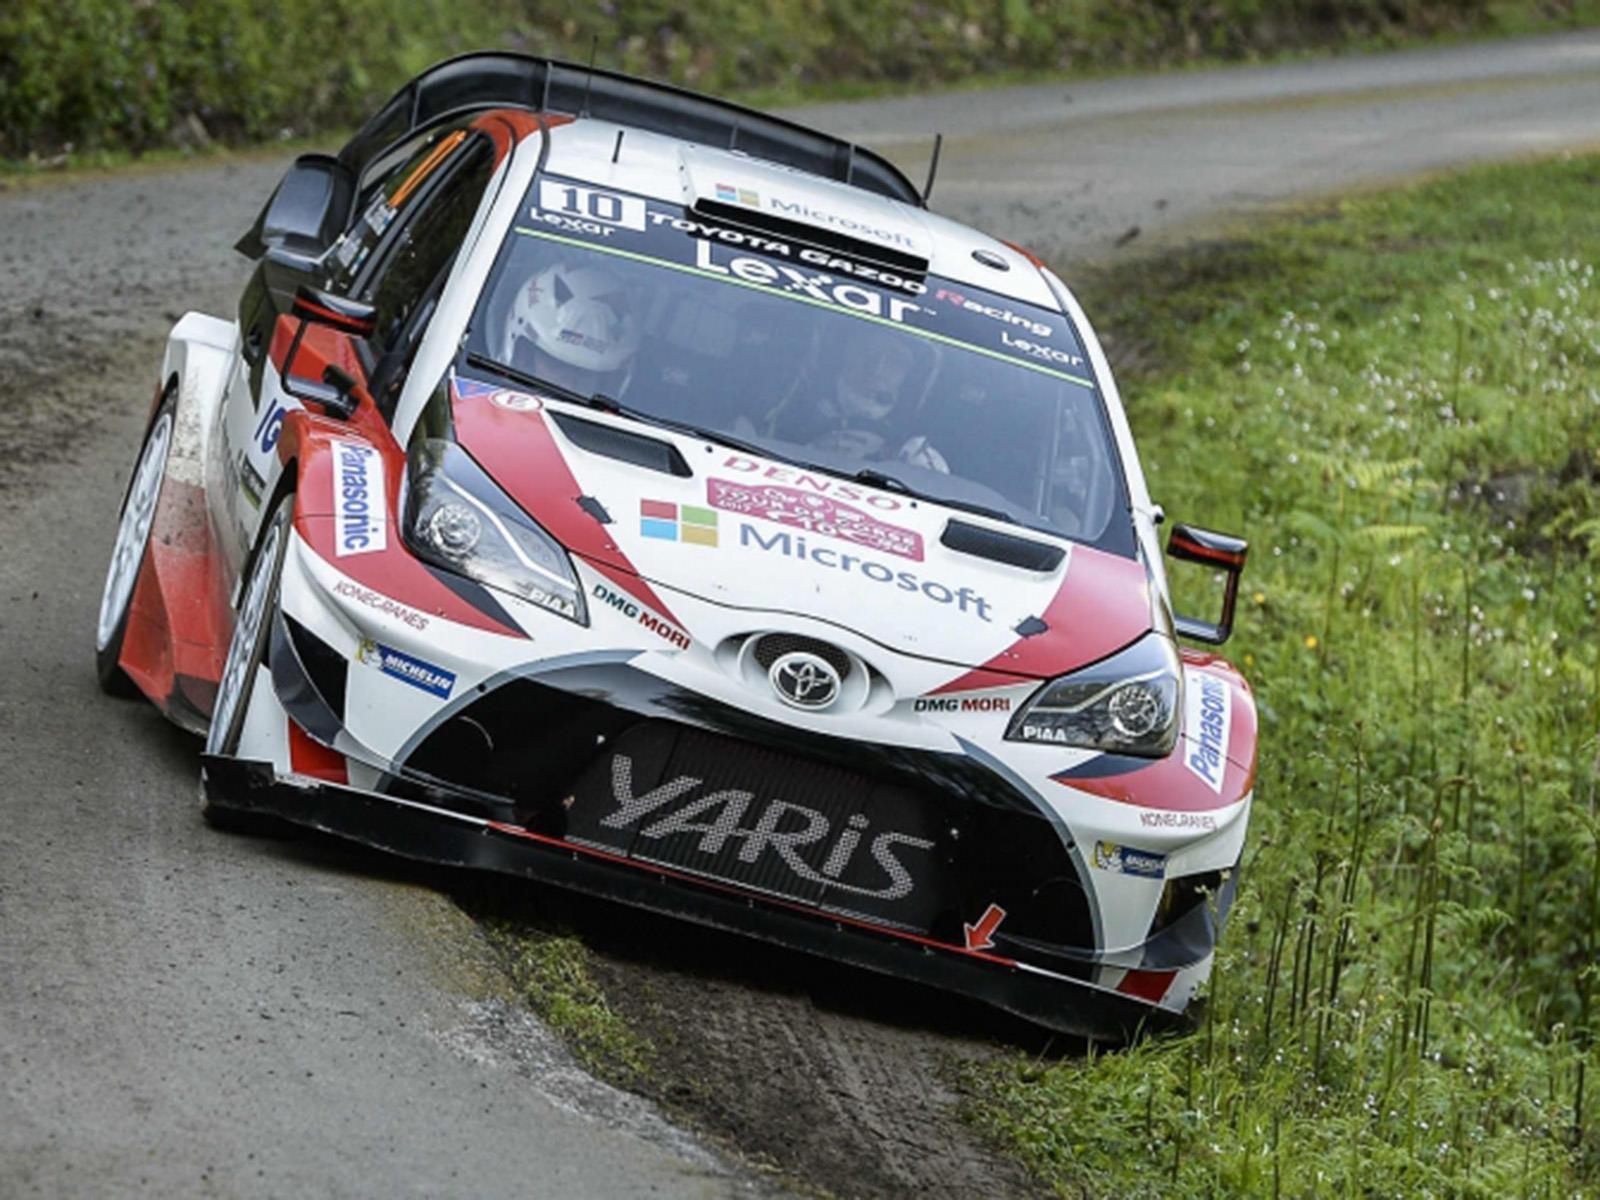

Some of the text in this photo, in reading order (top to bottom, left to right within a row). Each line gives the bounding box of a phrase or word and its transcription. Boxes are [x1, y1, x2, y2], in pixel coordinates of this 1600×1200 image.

[530, 207, 616, 238] Lexar
[561, 187, 623, 222] 10
[769, 199, 916, 249] Microsoft
[647, 210, 1053, 337] TOYOTA GAZOO Racing
[696, 238, 921, 323] Lexar
[1001, 331, 1084, 367] Lexar
[340, 442, 379, 550] Panasonic
[722, 456, 902, 511] DENSO
[740, 523, 994, 622] Microsoft
[592, 583, 692, 651] DMG MORI
[384, 653, 454, 690] MICHELIN
[914, 698, 1010, 712] DMG MORI
[1023, 726, 1067, 742] PIAA
